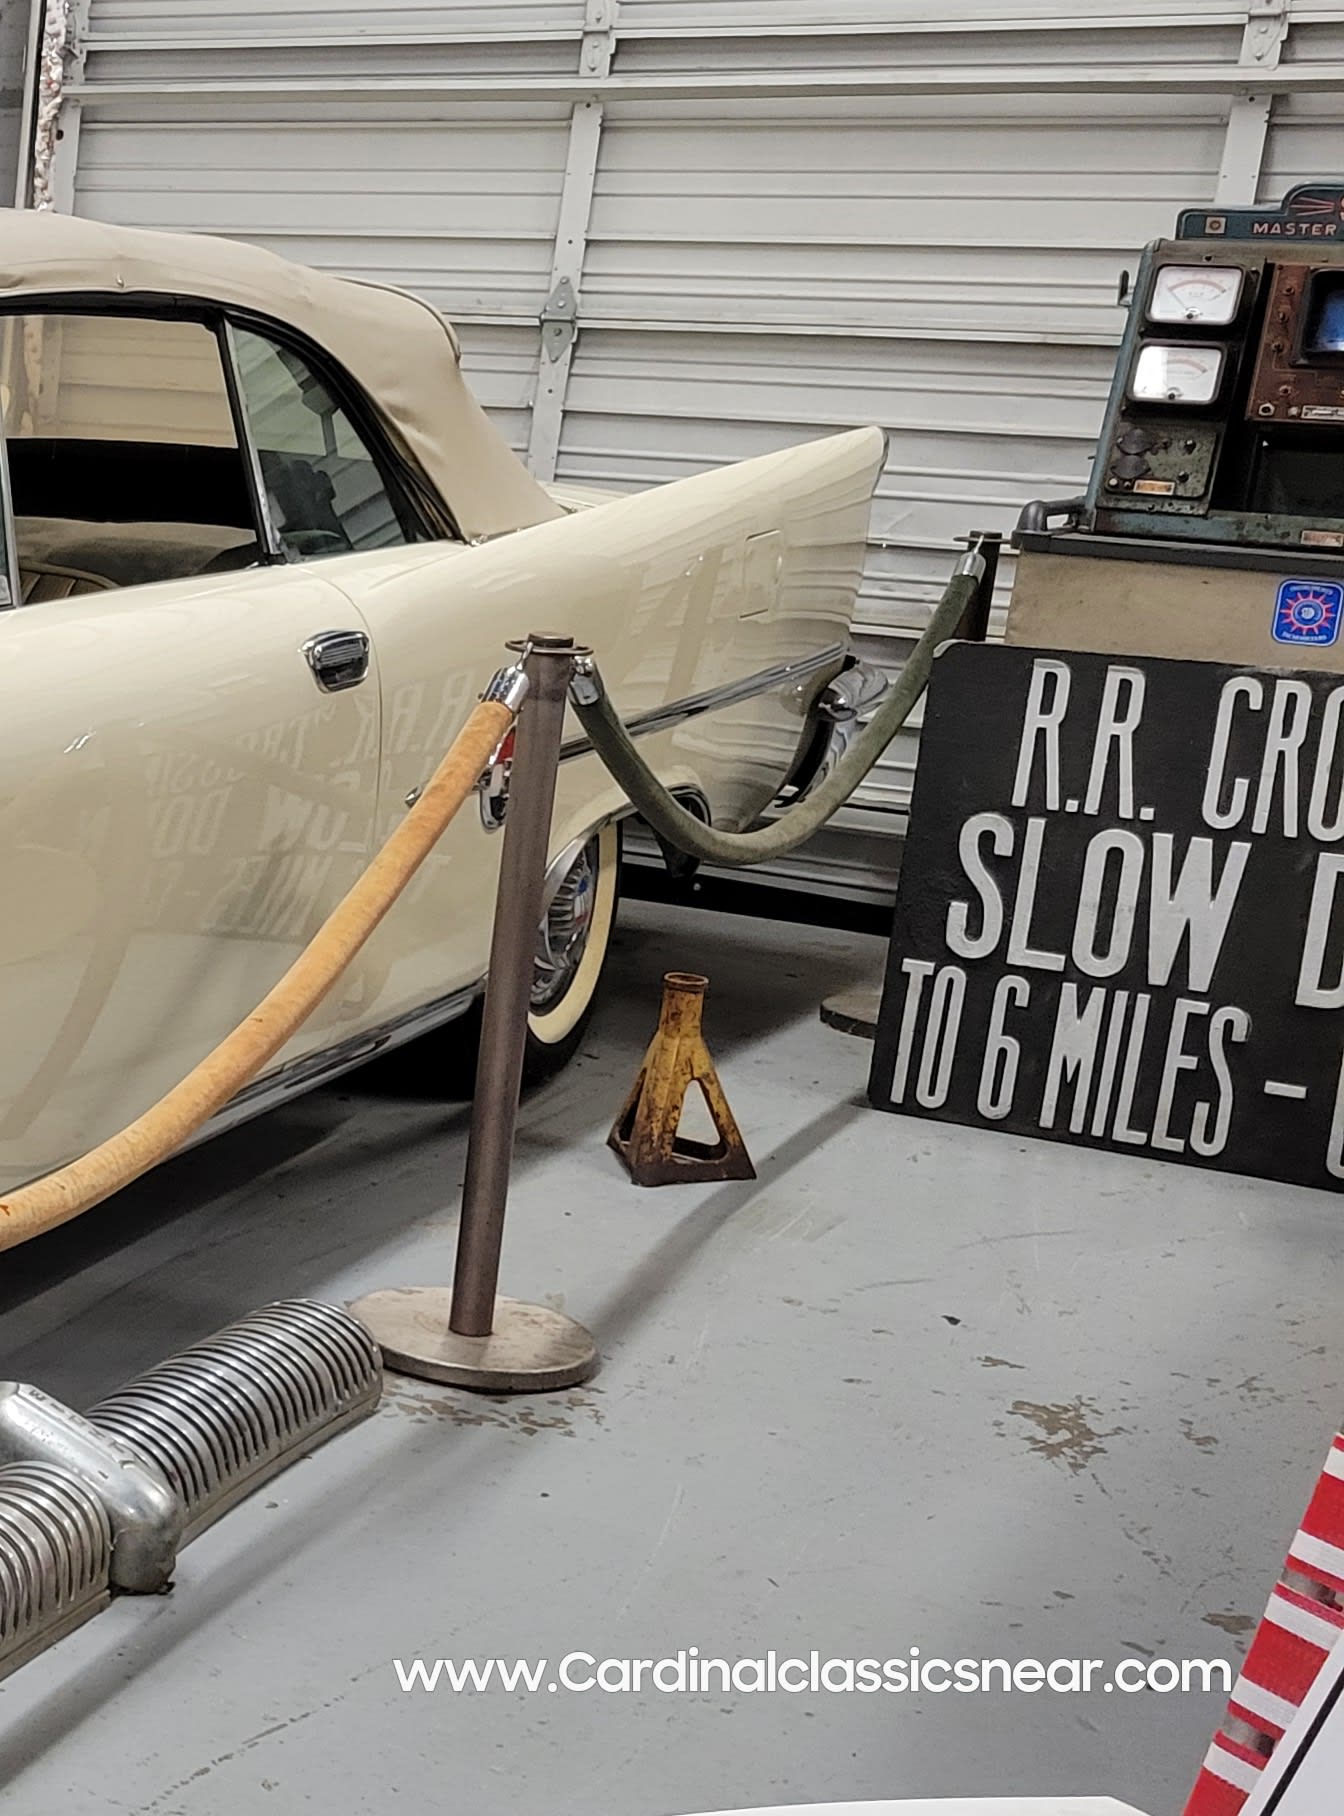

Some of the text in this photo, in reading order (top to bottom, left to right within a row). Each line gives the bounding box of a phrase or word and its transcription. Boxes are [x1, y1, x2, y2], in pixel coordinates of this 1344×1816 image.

[1253, 222, 1337, 236] MASTER
[1012, 658, 1155, 820] R.R.
[945, 812, 1253, 993] SLOW
[890, 957, 967, 1109] TO
[977, 975, 1030, 1121] 6
[1038, 981, 1249, 1157] MILES
